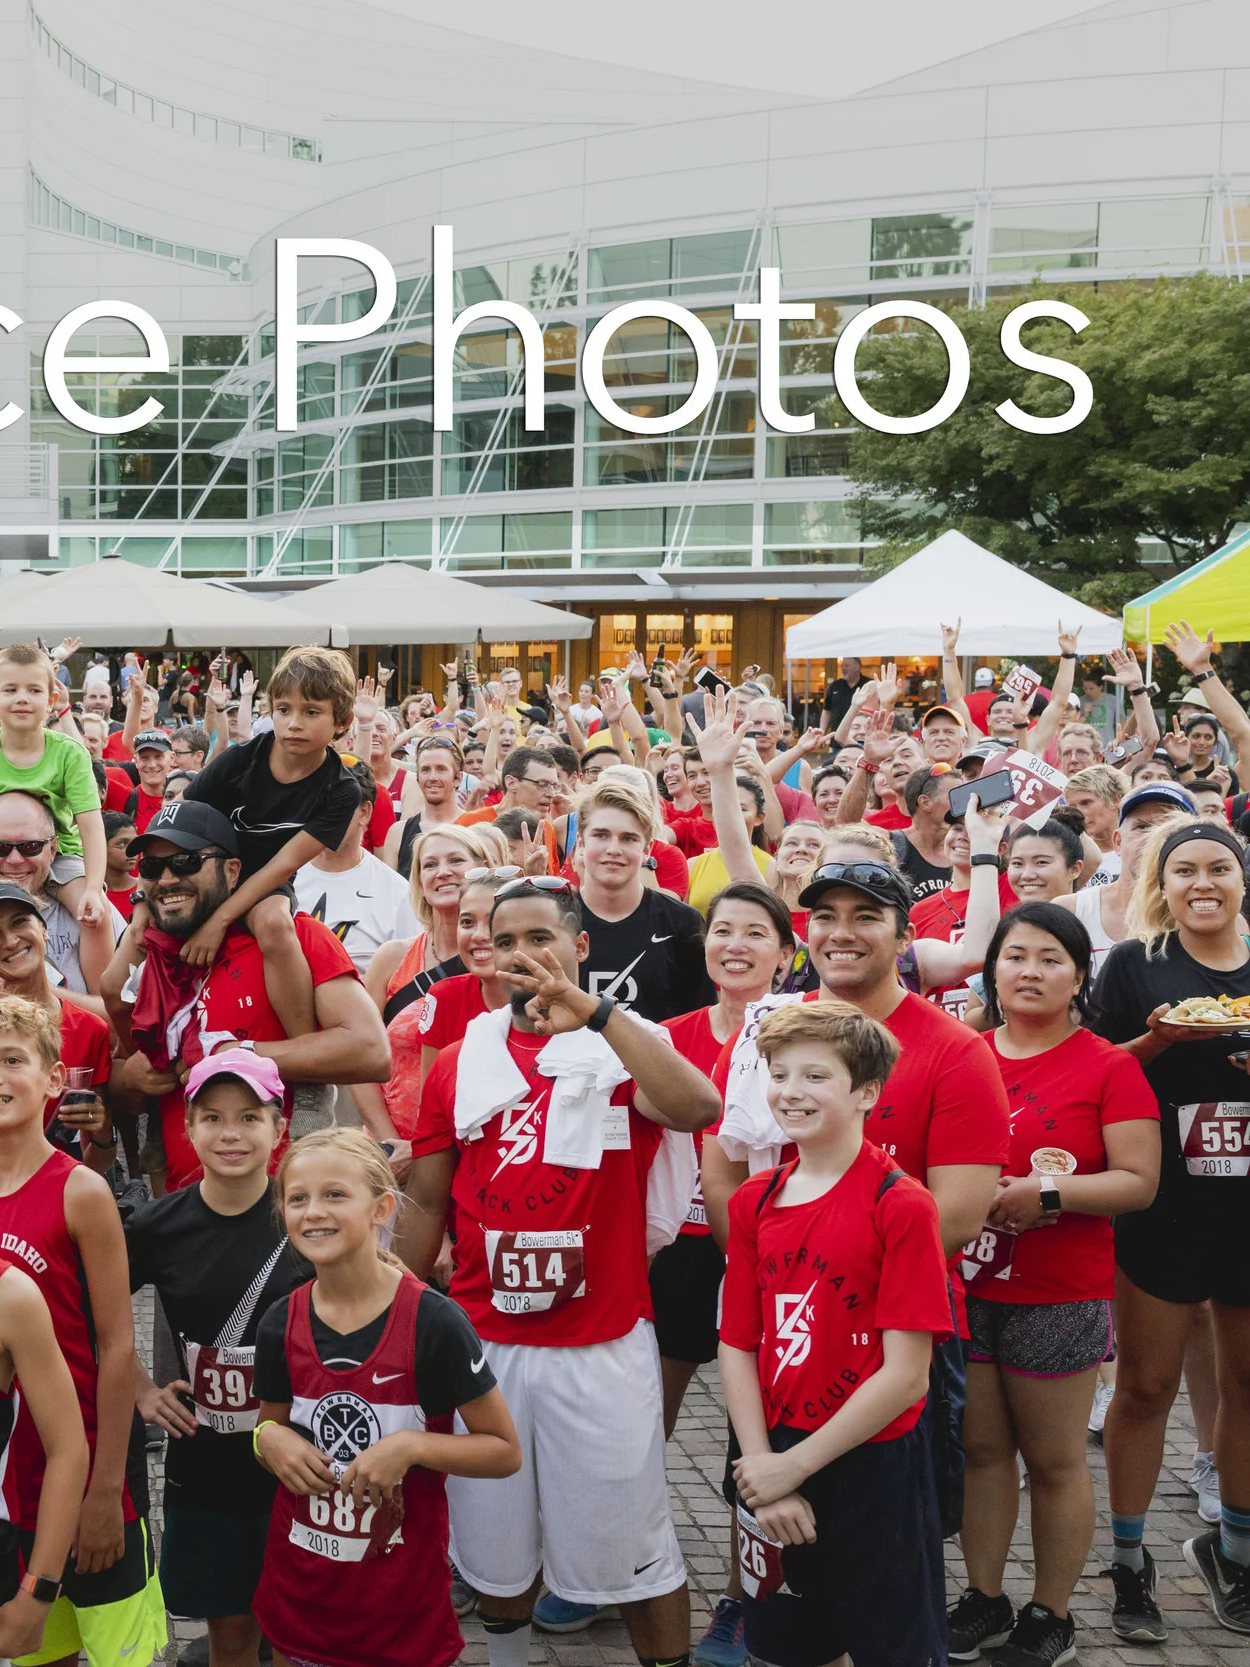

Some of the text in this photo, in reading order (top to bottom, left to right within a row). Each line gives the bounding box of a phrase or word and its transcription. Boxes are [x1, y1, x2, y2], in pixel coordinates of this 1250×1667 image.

[1028, 757, 1055, 781] 2018
[238, 995, 253, 1009] 18
[1222, 1102, 1250, 1116] Bowerm
[1201, 1159, 1232, 1174] 2018
[469, 1166, 579, 1213] TACK CLUB
[686, 1206, 705, 1222] 201
[521, 1233, 564, 1248] Bowerman
[0, 1232, 48, 1274] IDAHO
[501, 1252, 567, 1289] 514
[503, 1295, 531, 1311] 2018
[851, 1333, 869, 1346] 18
[803, 1368, 860, 1418] CLUB
[307, 1531, 340, 1558] 2018
